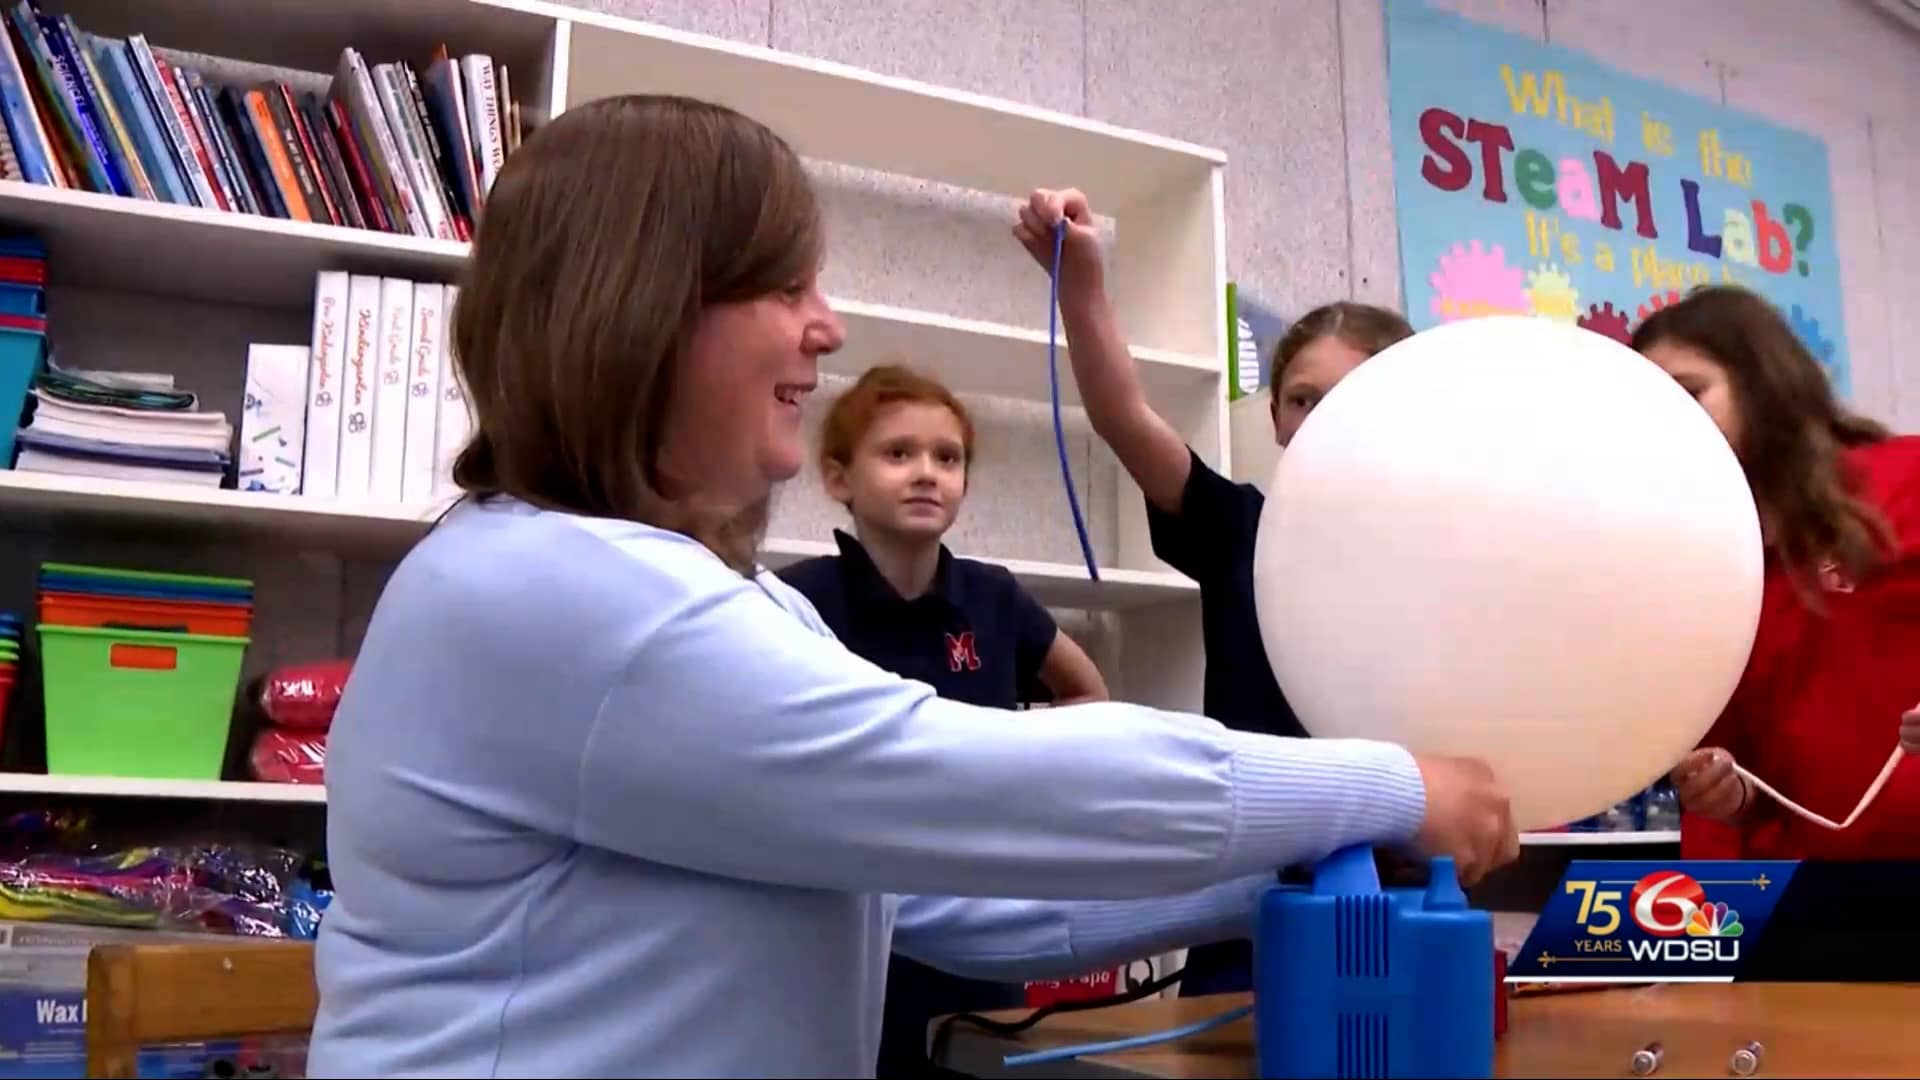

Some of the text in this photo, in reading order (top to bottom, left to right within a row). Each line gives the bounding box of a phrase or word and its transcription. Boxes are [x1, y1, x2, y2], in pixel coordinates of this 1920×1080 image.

[485, 95, 498, 143] THINGS
[1501, 64, 1752, 186] What is the
[1525, 208, 1583, 264] It's
[1594, 242, 1615, 273] a
[1680, 178, 1814, 277] Lab?
[352, 308, 372, 406] Kindergarten
[944, 631, 981, 671] M
[36, 999, 79, 1024] Wax
